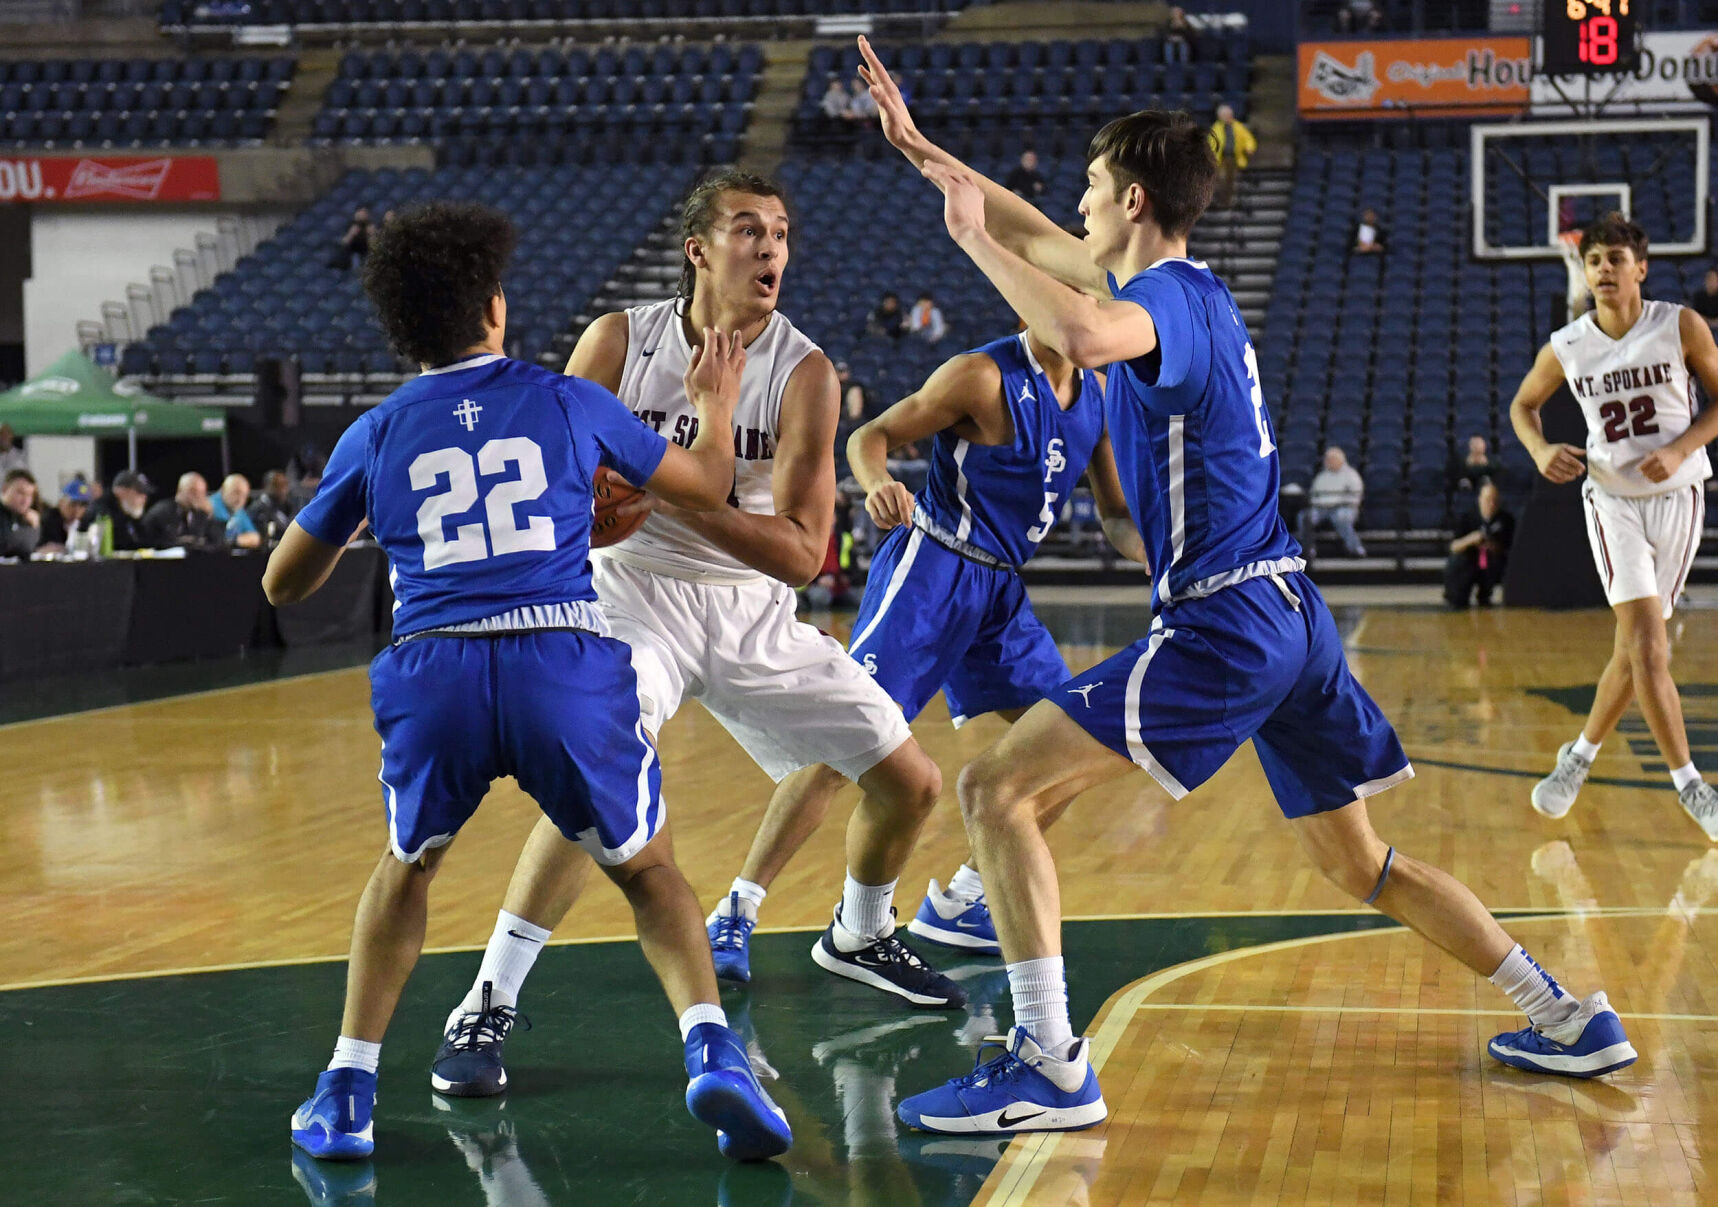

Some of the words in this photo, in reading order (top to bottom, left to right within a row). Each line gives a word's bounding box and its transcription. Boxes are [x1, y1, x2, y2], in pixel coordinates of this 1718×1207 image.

[1578, 16, 1618, 65] 18
[1574, 376, 1599, 398] MT.
[1603, 363, 1672, 393] SPOKANE
[672, 414, 774, 460] SPANE
[1600, 395, 1659, 442] 22
[408, 436, 556, 571] 22
[1026, 492, 1058, 543] 5
